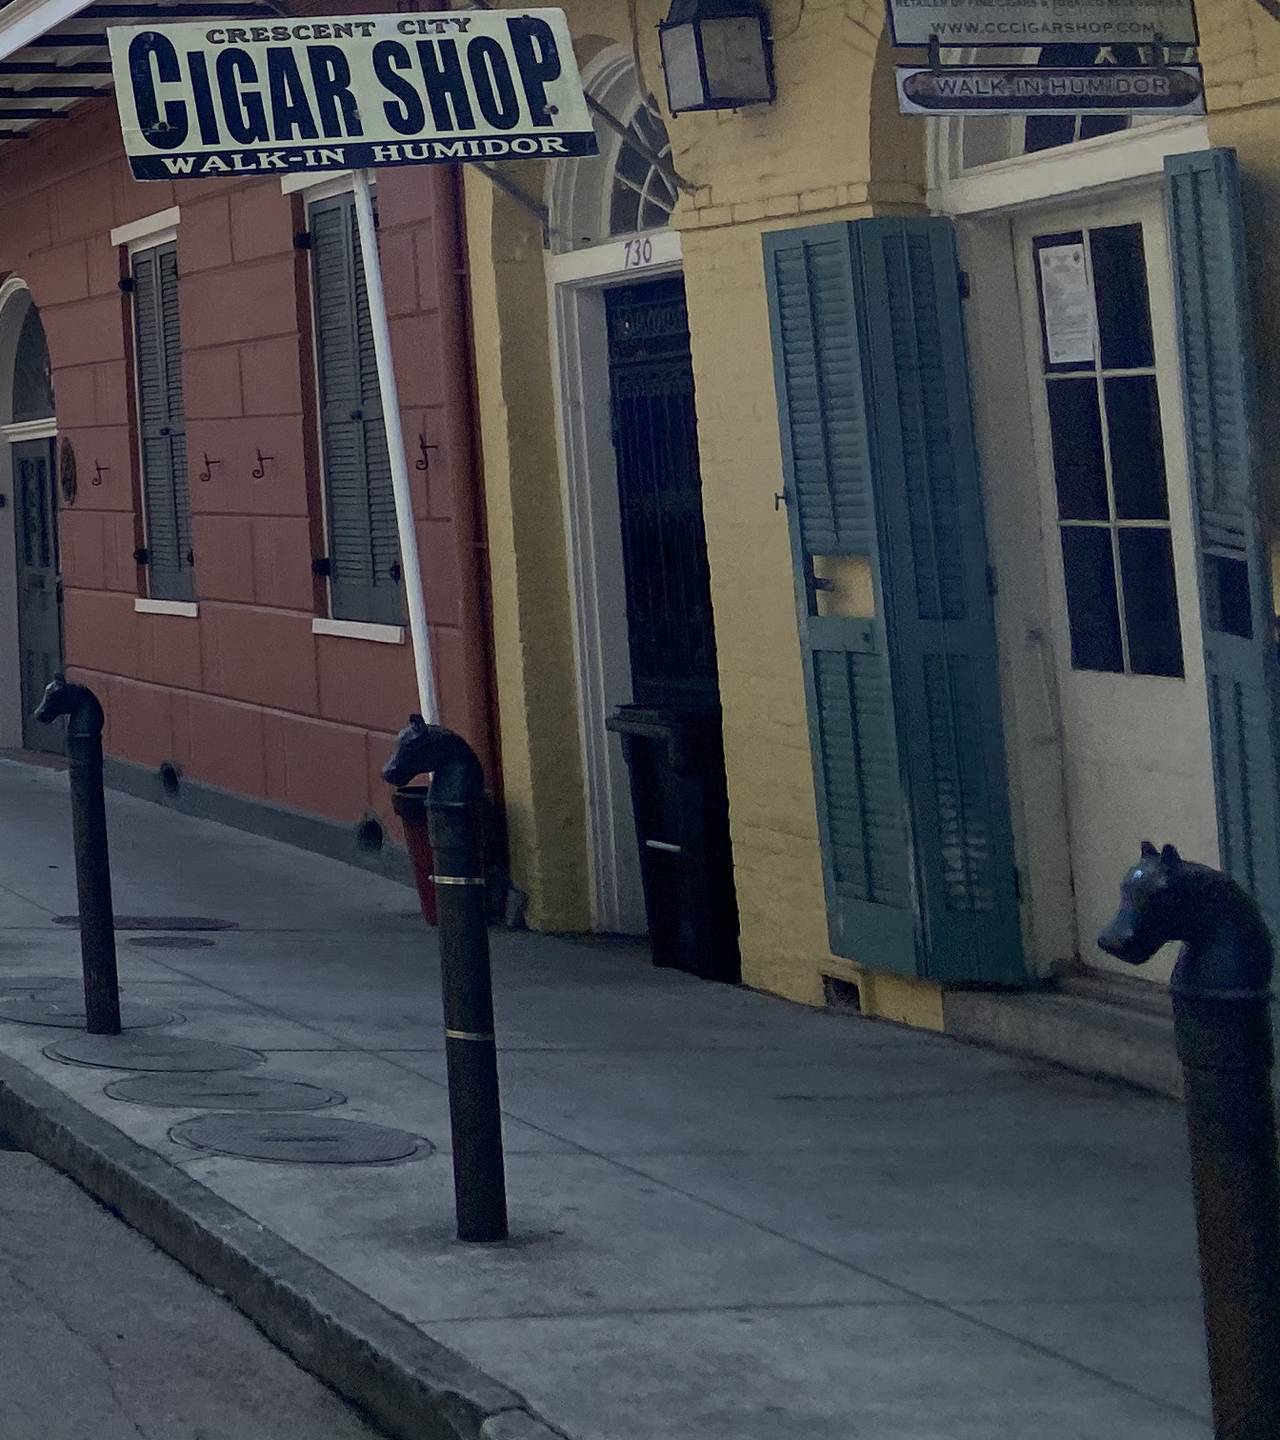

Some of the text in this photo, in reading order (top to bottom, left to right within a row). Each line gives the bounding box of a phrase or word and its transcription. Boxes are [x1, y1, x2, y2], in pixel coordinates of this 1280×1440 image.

[206, 16, 472, 45] CRESCENT CITY
[930, 22, 1156, 34] WWW.CCCIGARSHOP.COM
[128, 17, 562, 150] CIGAR SHOP
[1050, 78, 1168, 95] HUMIDOR
[161, 136, 569, 175] WALK-IN HUMIDOR
[624, 238, 653, 269] 730
